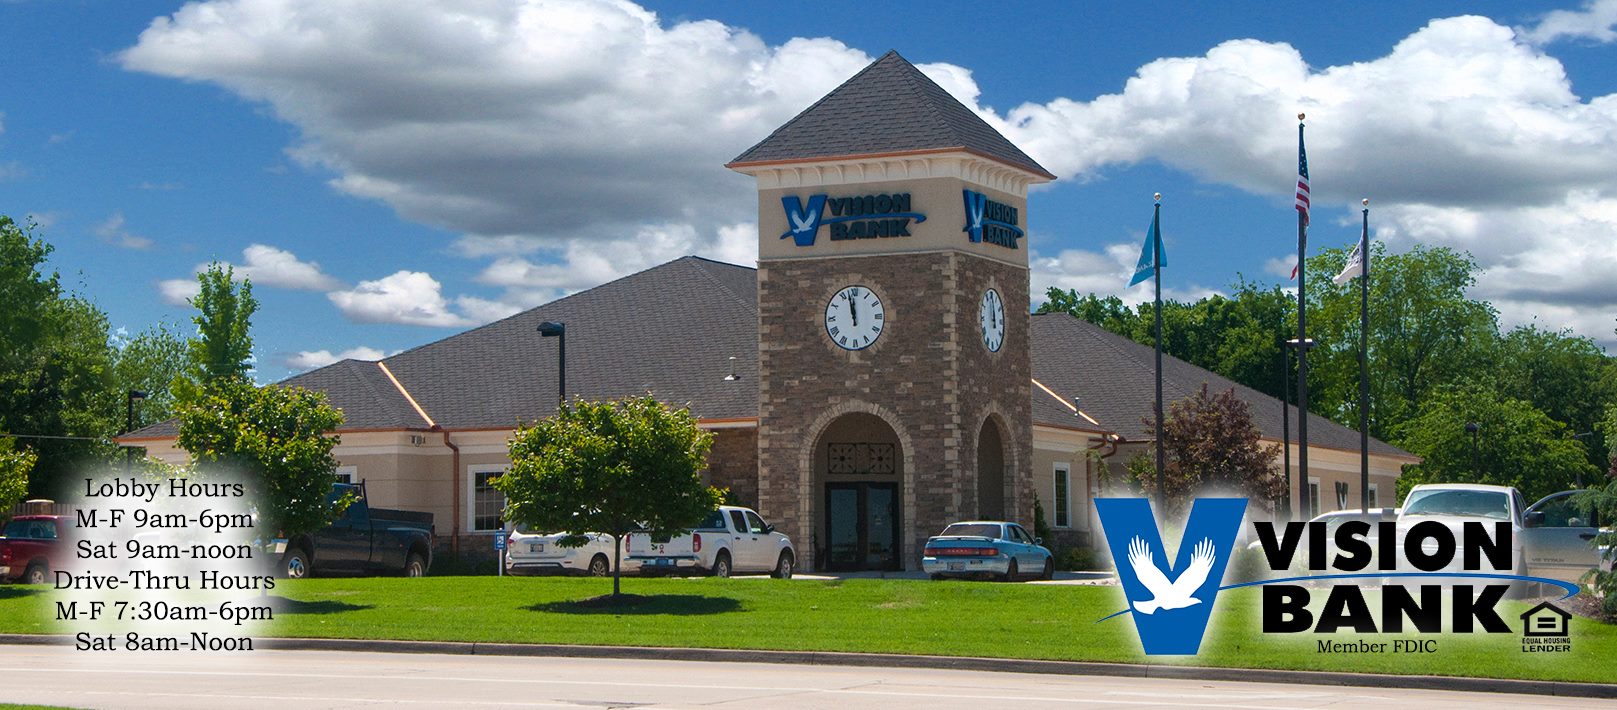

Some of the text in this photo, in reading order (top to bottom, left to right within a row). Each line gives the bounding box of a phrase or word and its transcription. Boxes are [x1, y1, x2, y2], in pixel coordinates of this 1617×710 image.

[828, 193, 911, 216] VISION
[984, 200, 1019, 226] VISION
[830, 218, 911, 241] BANK
[983, 224, 1019, 249] BANK
